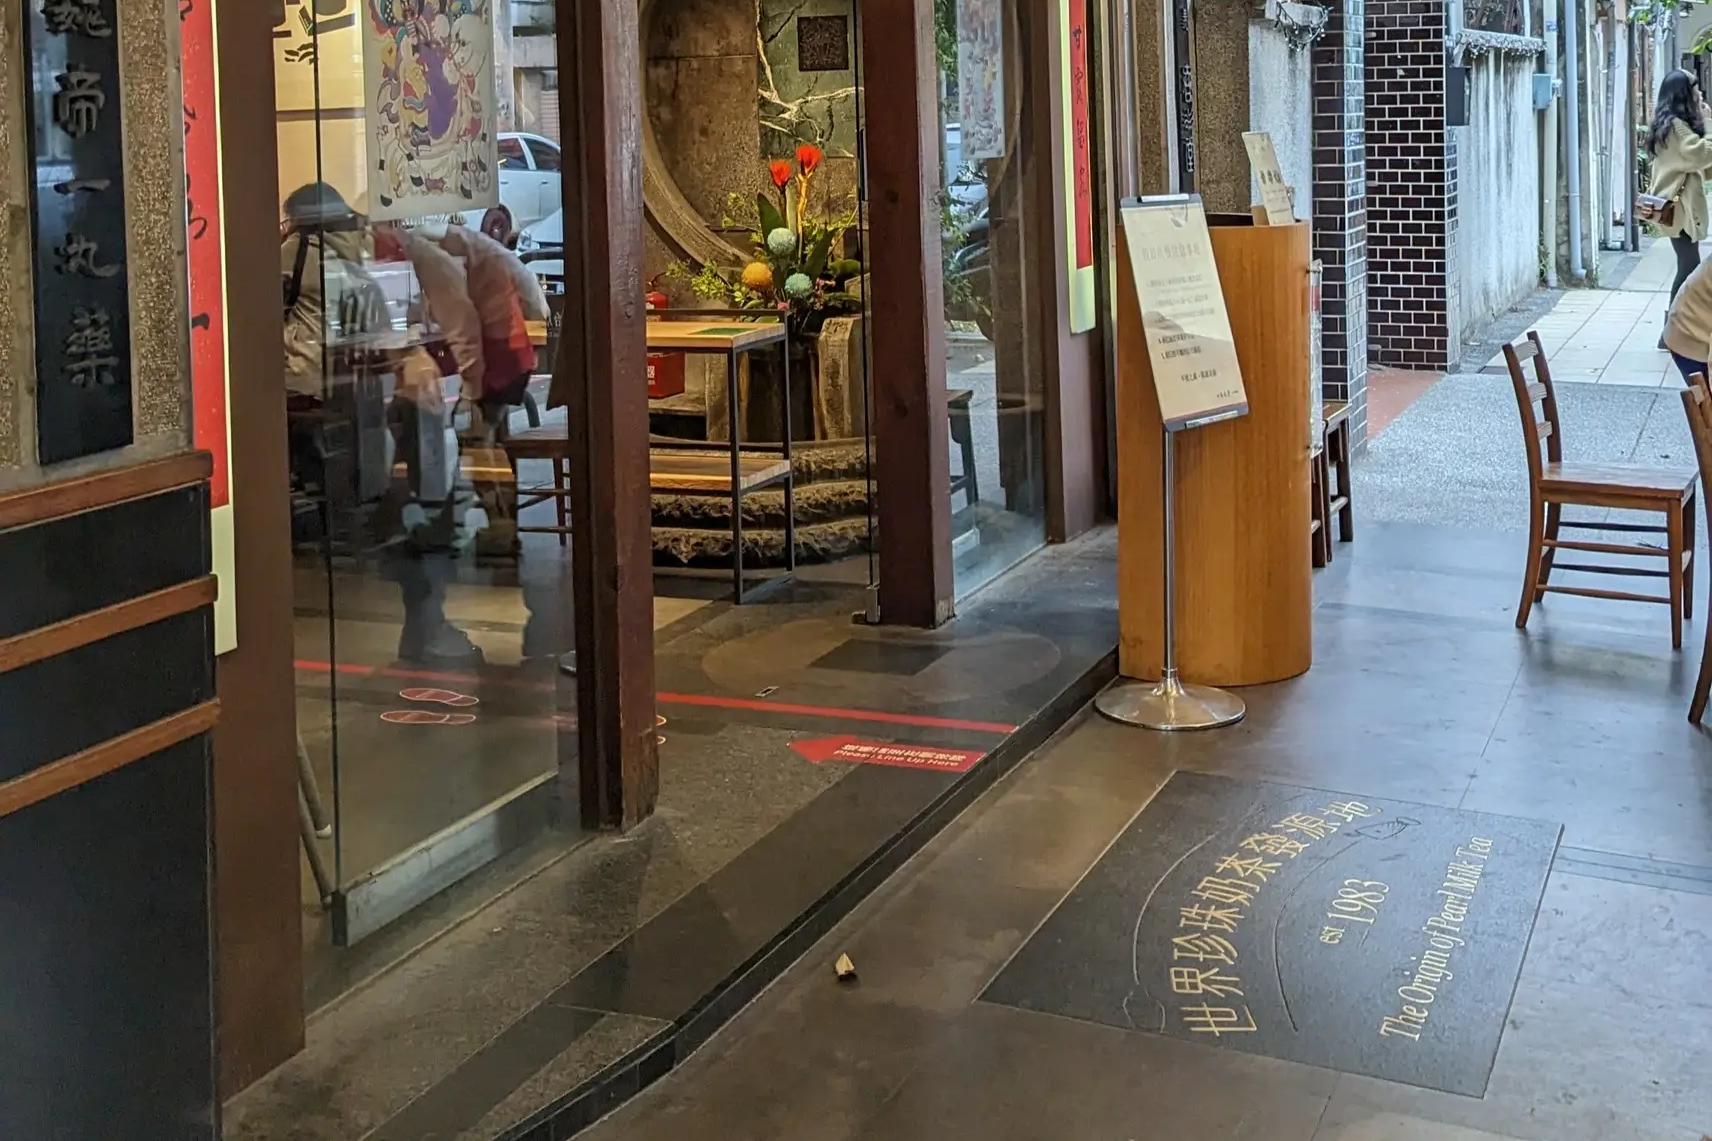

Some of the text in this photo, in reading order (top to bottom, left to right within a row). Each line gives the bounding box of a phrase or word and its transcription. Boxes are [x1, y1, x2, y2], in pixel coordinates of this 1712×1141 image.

[1169, 801, 1383, 1037] 世界珍珠奶茶發源地
[1319, 879, 1390, 945] est 1983
[1379, 835, 1494, 1042] The Origin of Pearl Milk Tea
